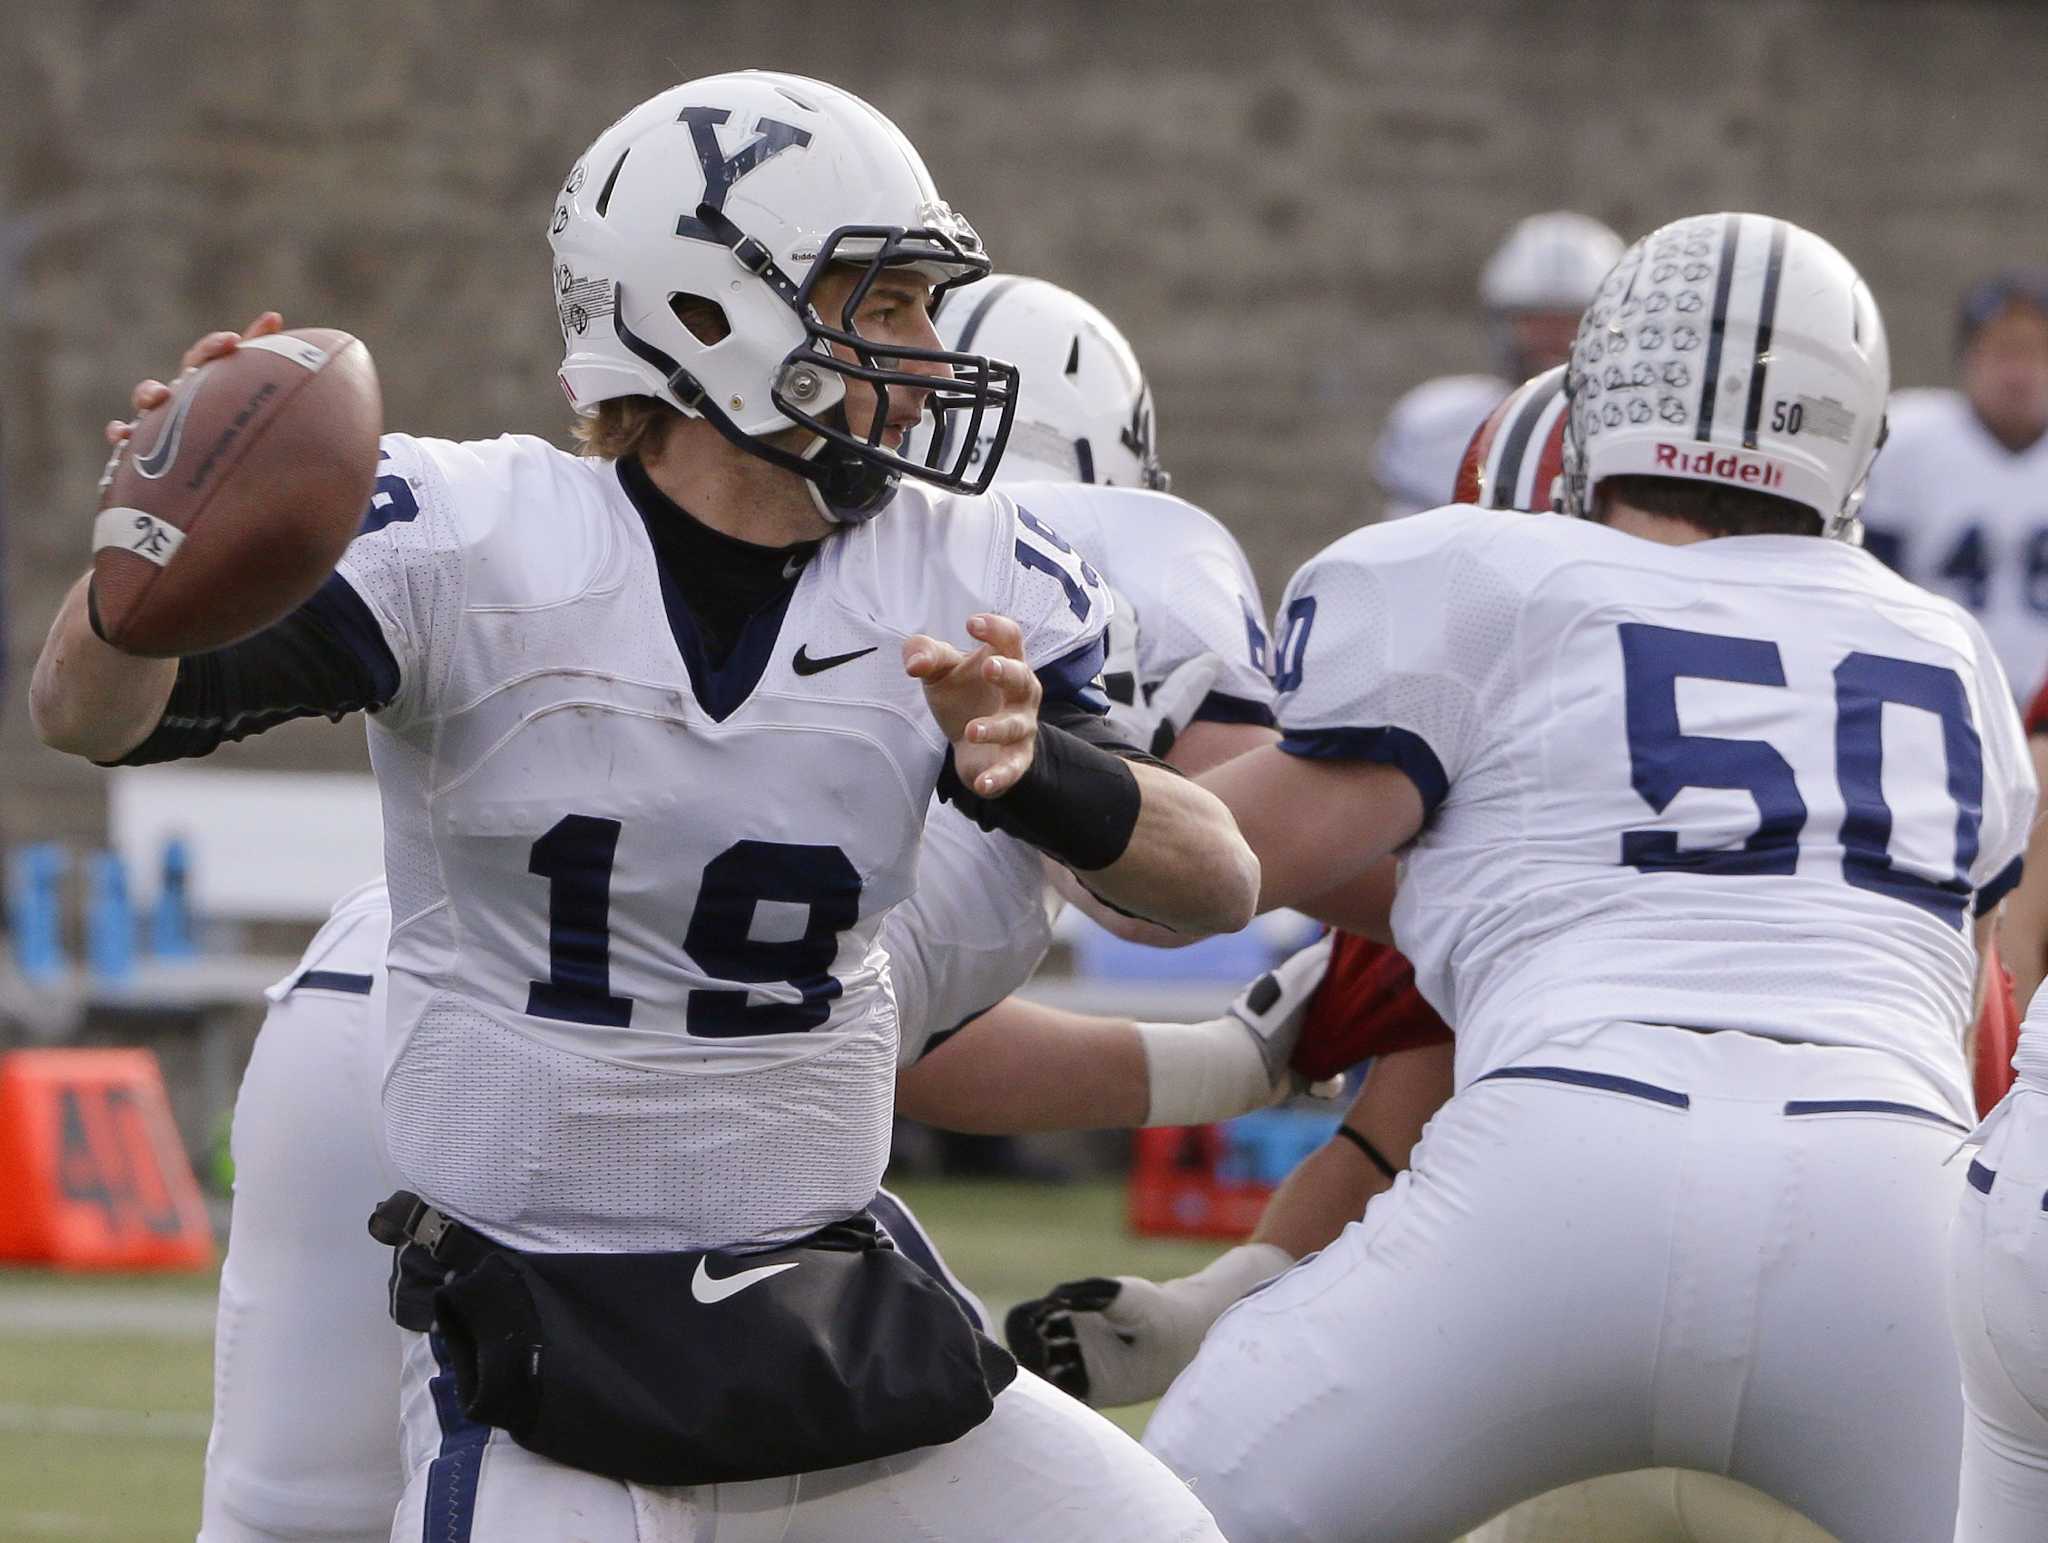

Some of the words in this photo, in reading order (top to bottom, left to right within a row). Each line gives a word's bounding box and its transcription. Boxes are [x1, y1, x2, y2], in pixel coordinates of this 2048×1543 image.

[674, 106, 813, 250] Y
[1655, 443, 1785, 488] Riddell
[1772, 401, 1804, 435] 50
[1617, 622, 1984, 932] 50
[525, 813, 863, 1039] 19
